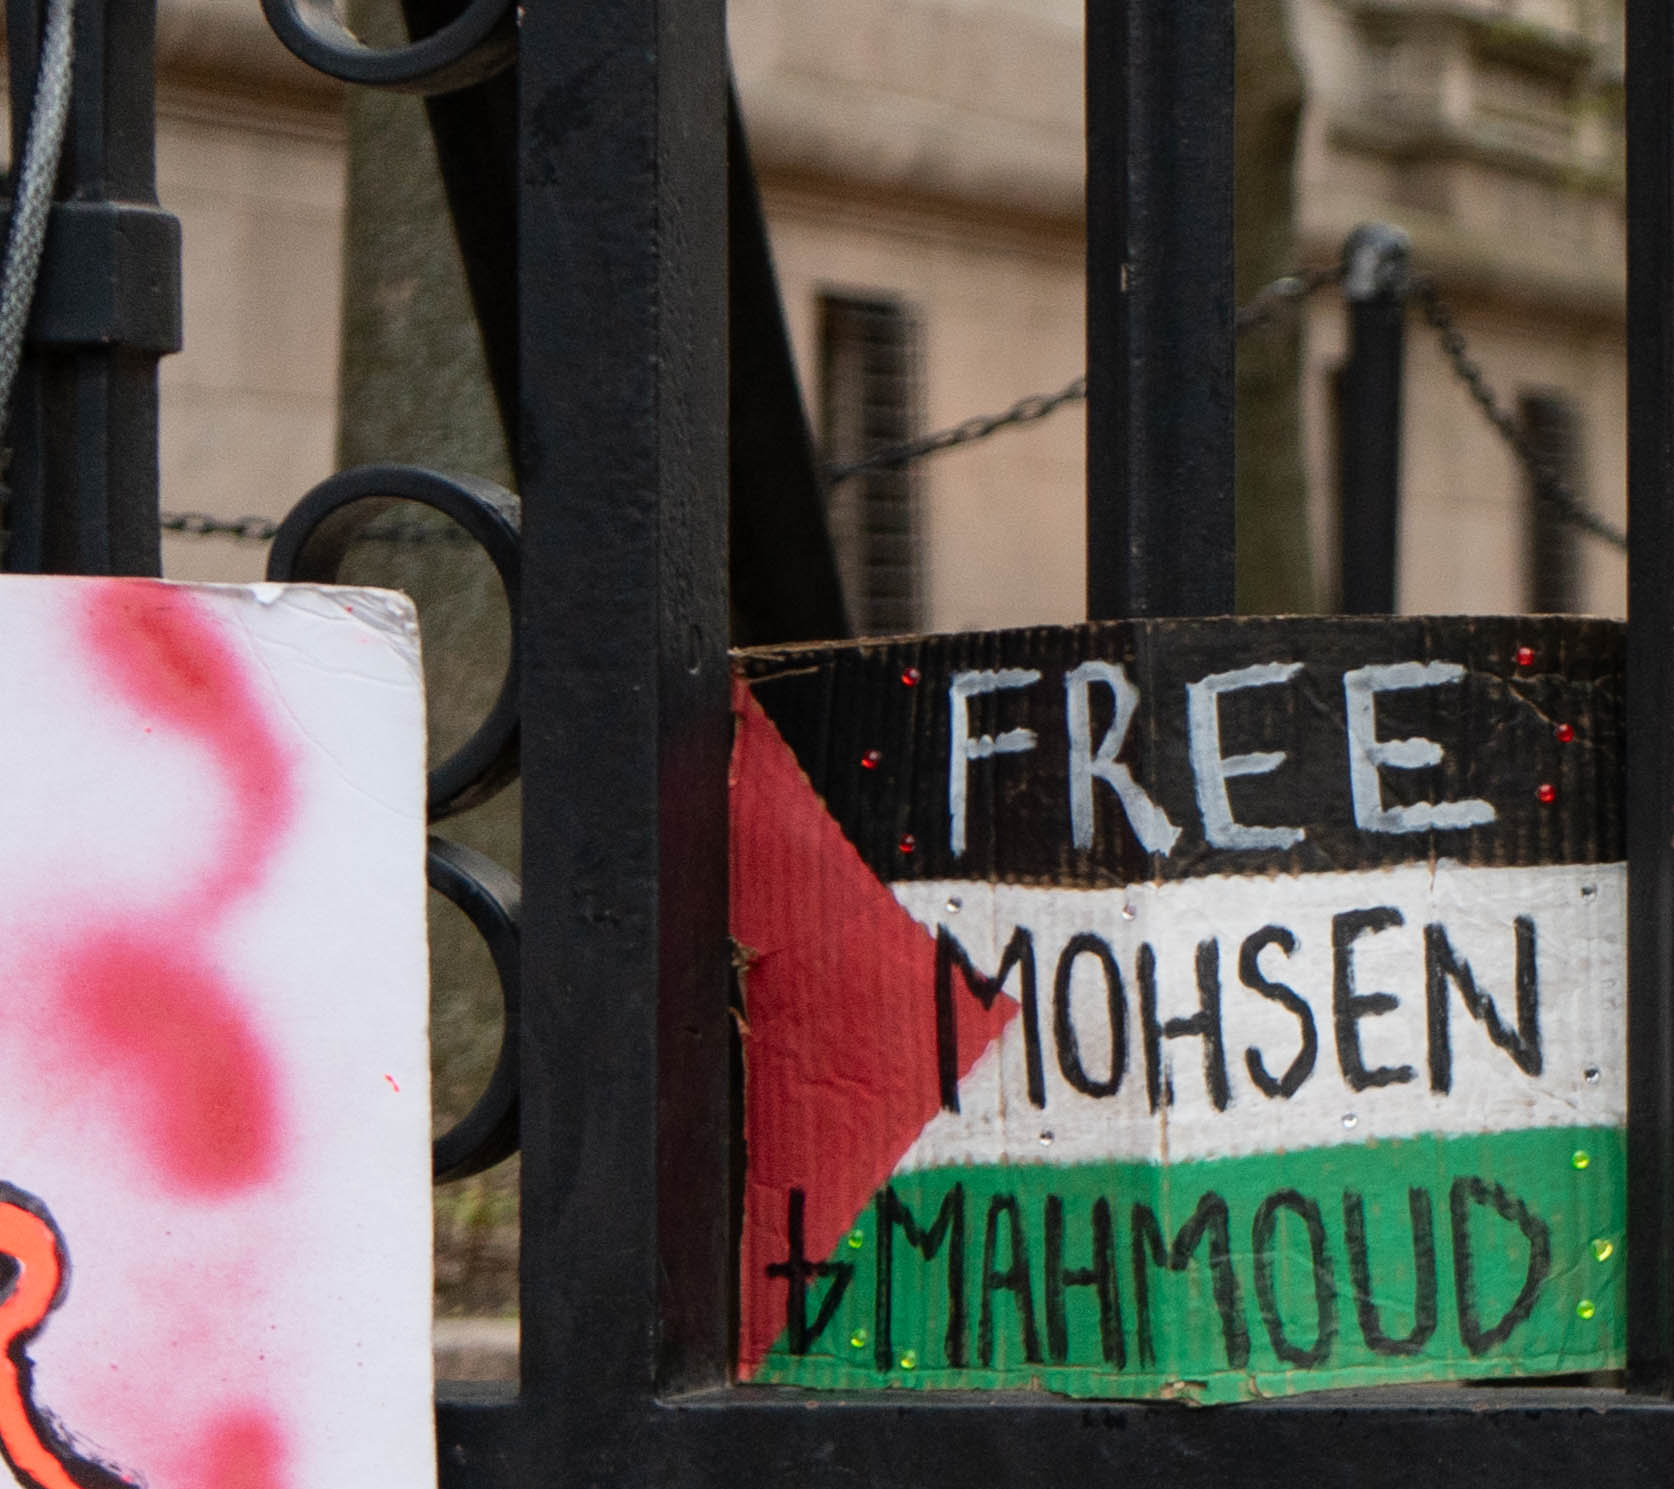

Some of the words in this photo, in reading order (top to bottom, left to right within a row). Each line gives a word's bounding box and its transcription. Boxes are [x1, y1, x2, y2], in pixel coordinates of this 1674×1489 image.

[947, 659, 1498, 860] FREE
[934, 906, 1544, 1113] MOHSEN
[875, 1176, 1551, 1373] MAHMOUD
